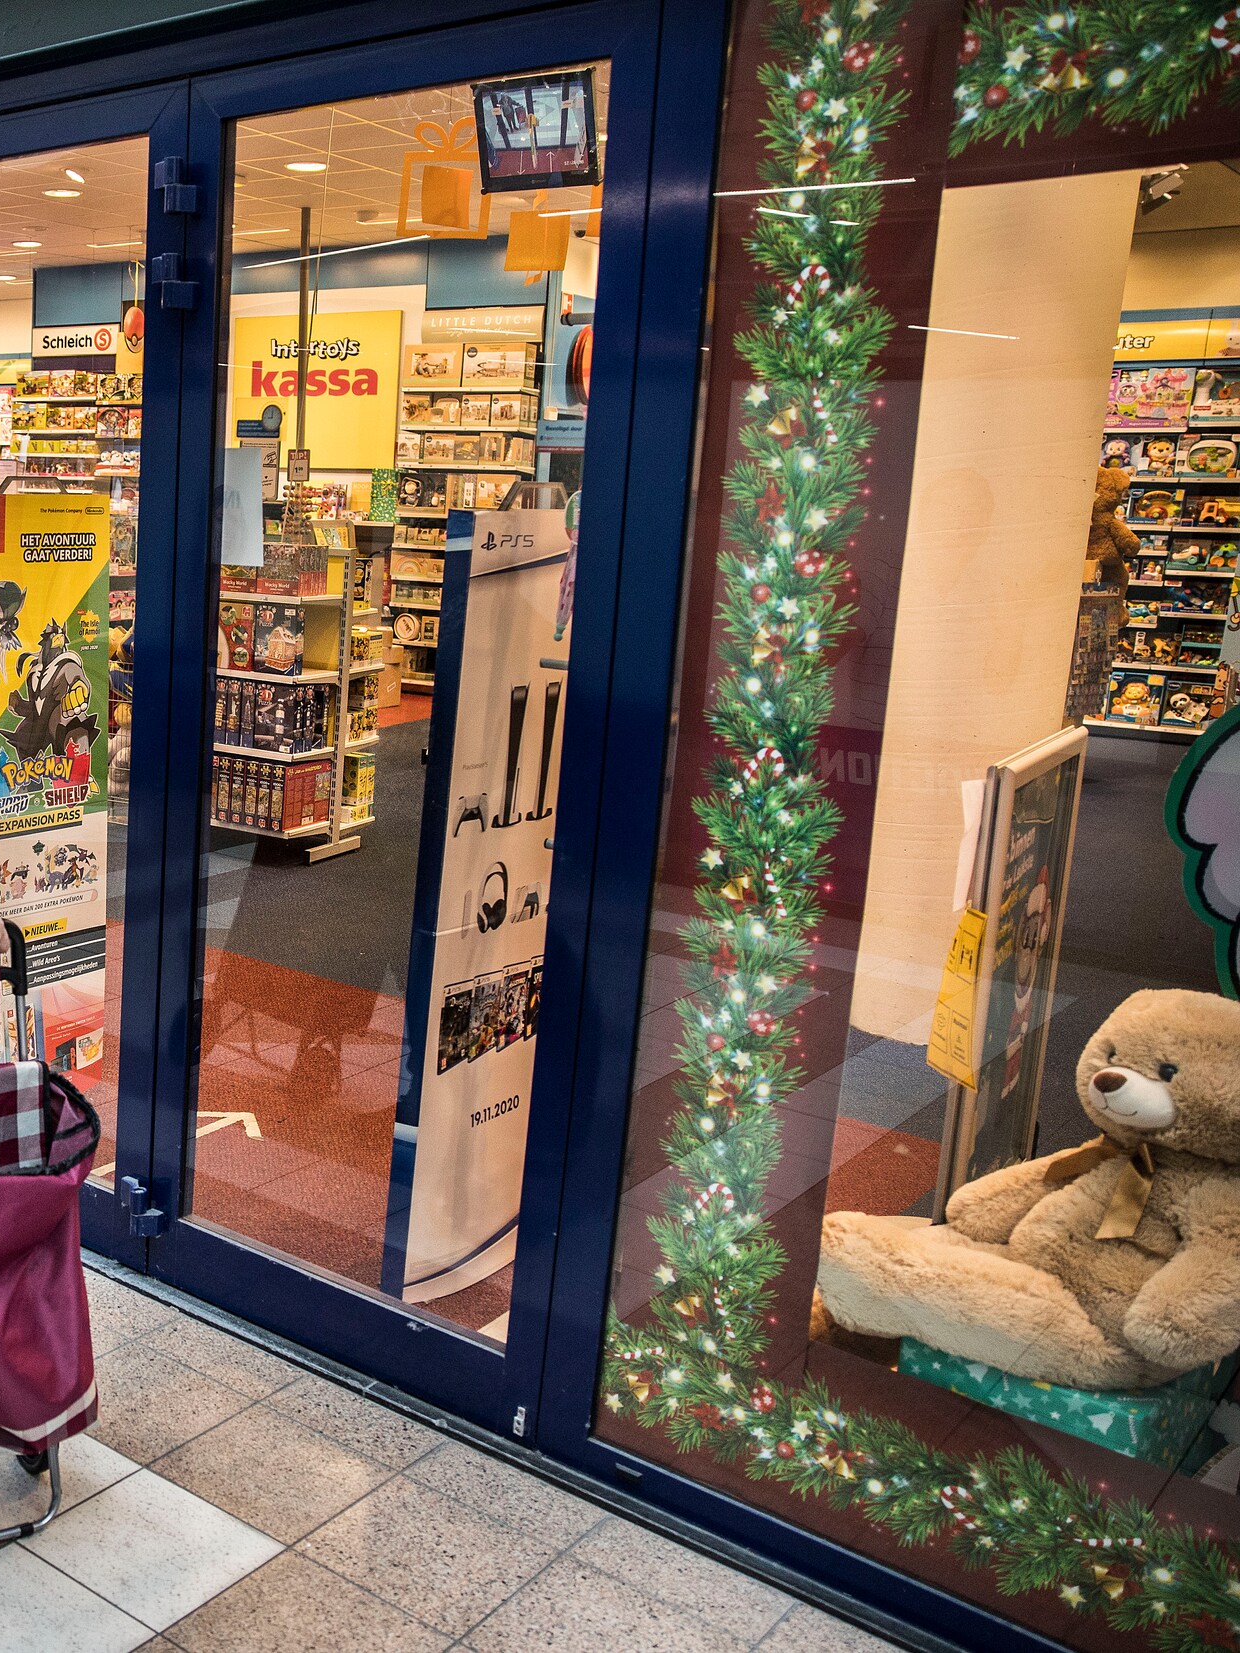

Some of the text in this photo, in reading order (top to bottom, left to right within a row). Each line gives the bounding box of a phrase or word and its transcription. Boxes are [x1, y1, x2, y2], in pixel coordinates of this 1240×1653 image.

[431, 315, 532, 328] LITTLE DUTCH
[42, 333, 92, 349] Schleich
[271, 337, 360, 361] Intrtoys
[251, 360, 379, 397] kassa
[290, 452, 307, 460] TIP!
[21, 533, 96, 547] HET AVONTUUR
[500, 534, 535, 548] PS5
[24, 548, 92, 562] GAAT VERDER!
[90, 619, 99, 627] Isle
[44, 785, 90, 808] SHIELD
[57, 809, 81, 821] PASS
[9, 906, 23, 916] MEER
[23, 904, 34, 913] DAN
[44, 899, 59, 908] EXTRA
[31, 922, 64, 936] NIEUWE...
[471, 1095, 520, 1127] 19.11.2020
